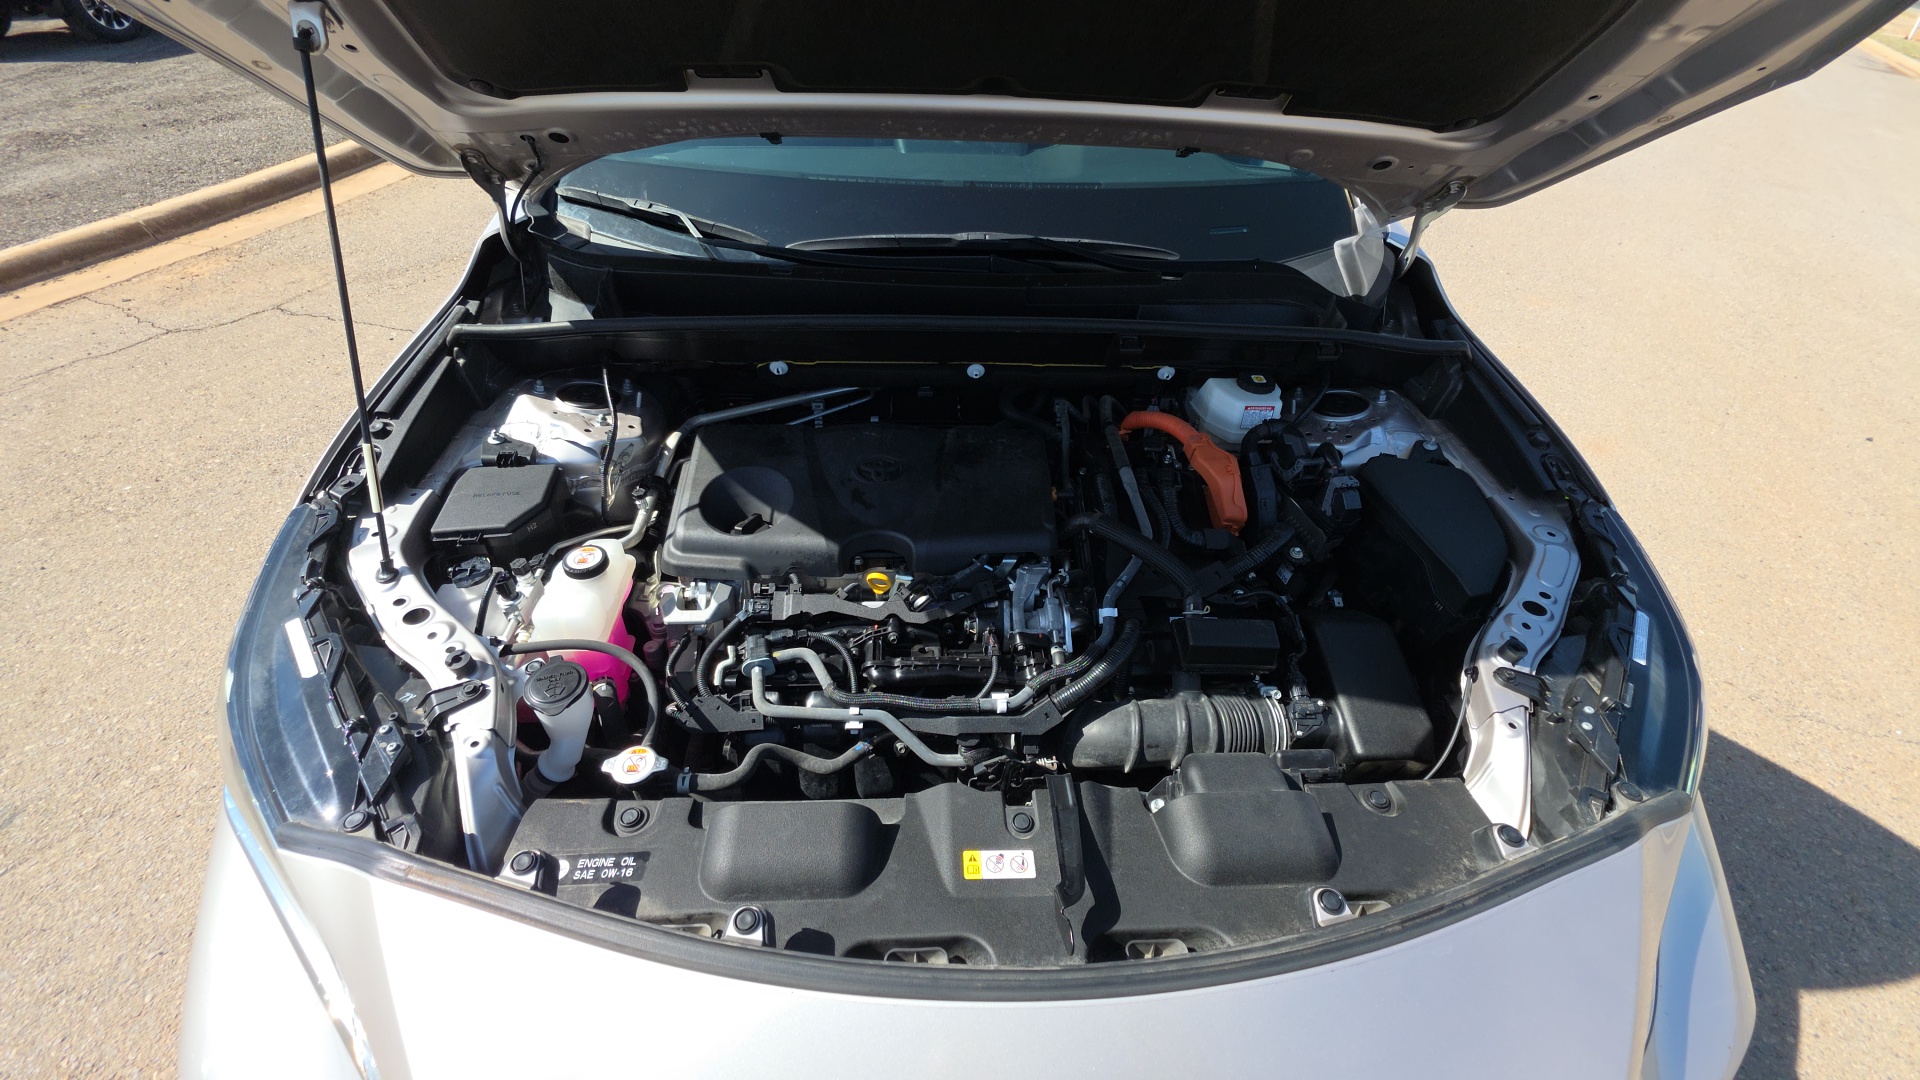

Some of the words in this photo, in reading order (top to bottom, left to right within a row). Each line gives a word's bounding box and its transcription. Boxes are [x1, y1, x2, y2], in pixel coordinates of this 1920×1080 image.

[526, 522, 538, 533] H2
[577, 857, 616, 869] ENGINE
[620, 856, 637, 866] OIL
[573, 869, 596, 880] SAE
[600, 867, 634, 878] 0W-16
